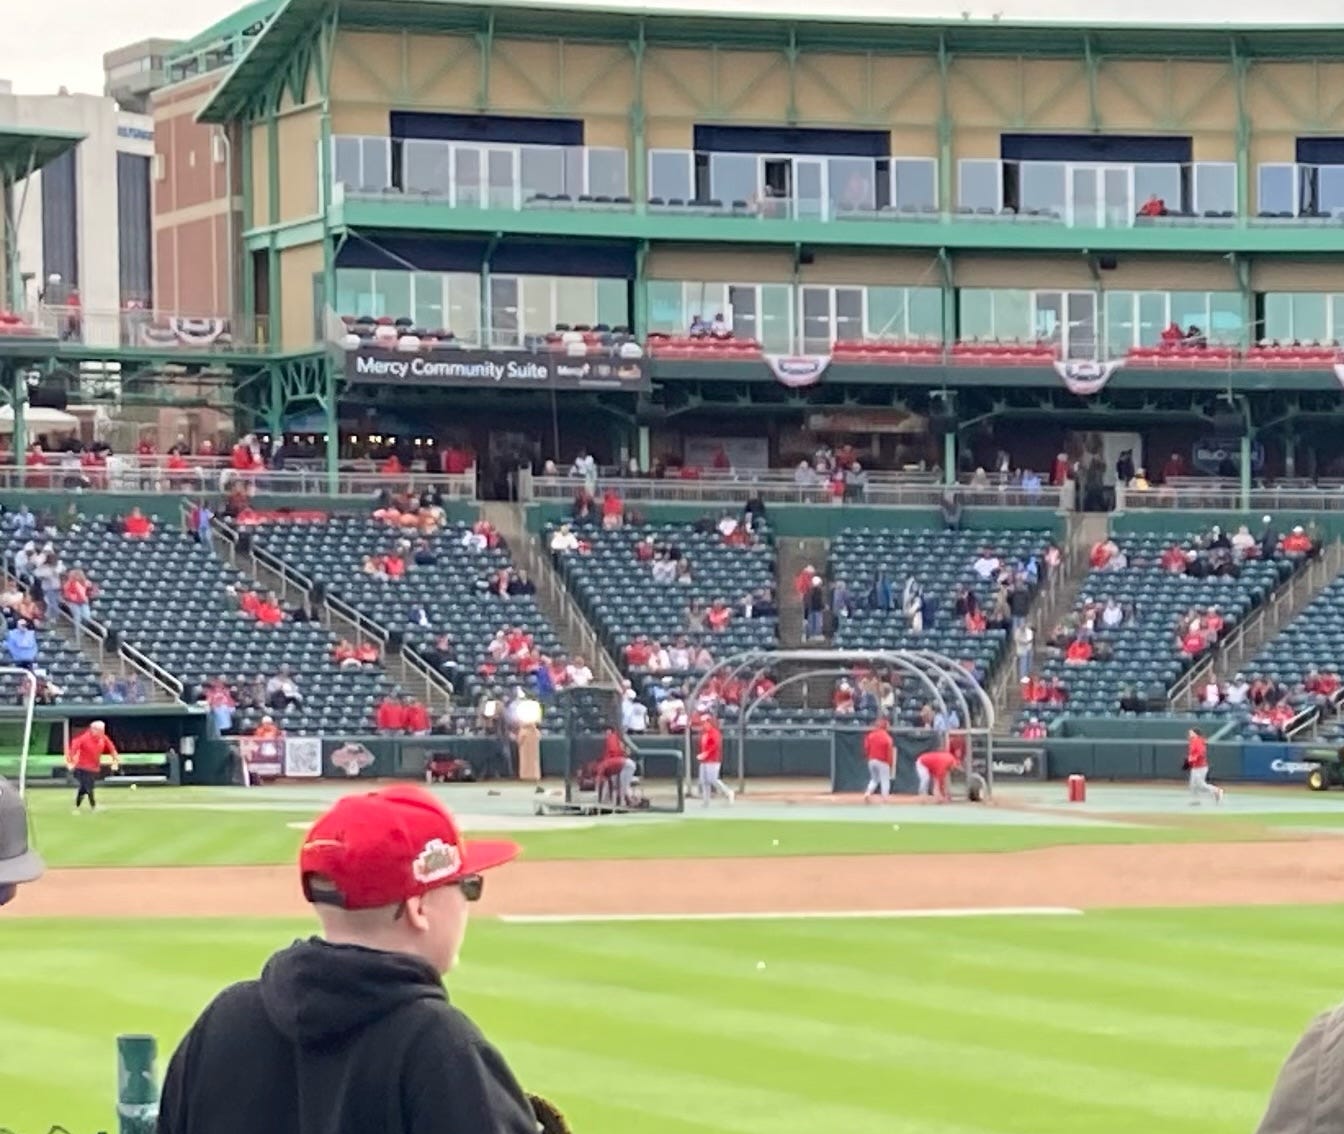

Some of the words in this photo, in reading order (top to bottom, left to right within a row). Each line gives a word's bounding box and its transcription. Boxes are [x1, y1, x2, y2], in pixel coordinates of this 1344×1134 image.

[357, 356, 408, 376] Mercy
[411, 358, 504, 381] Community
[506, 361, 549, 379] Suite
